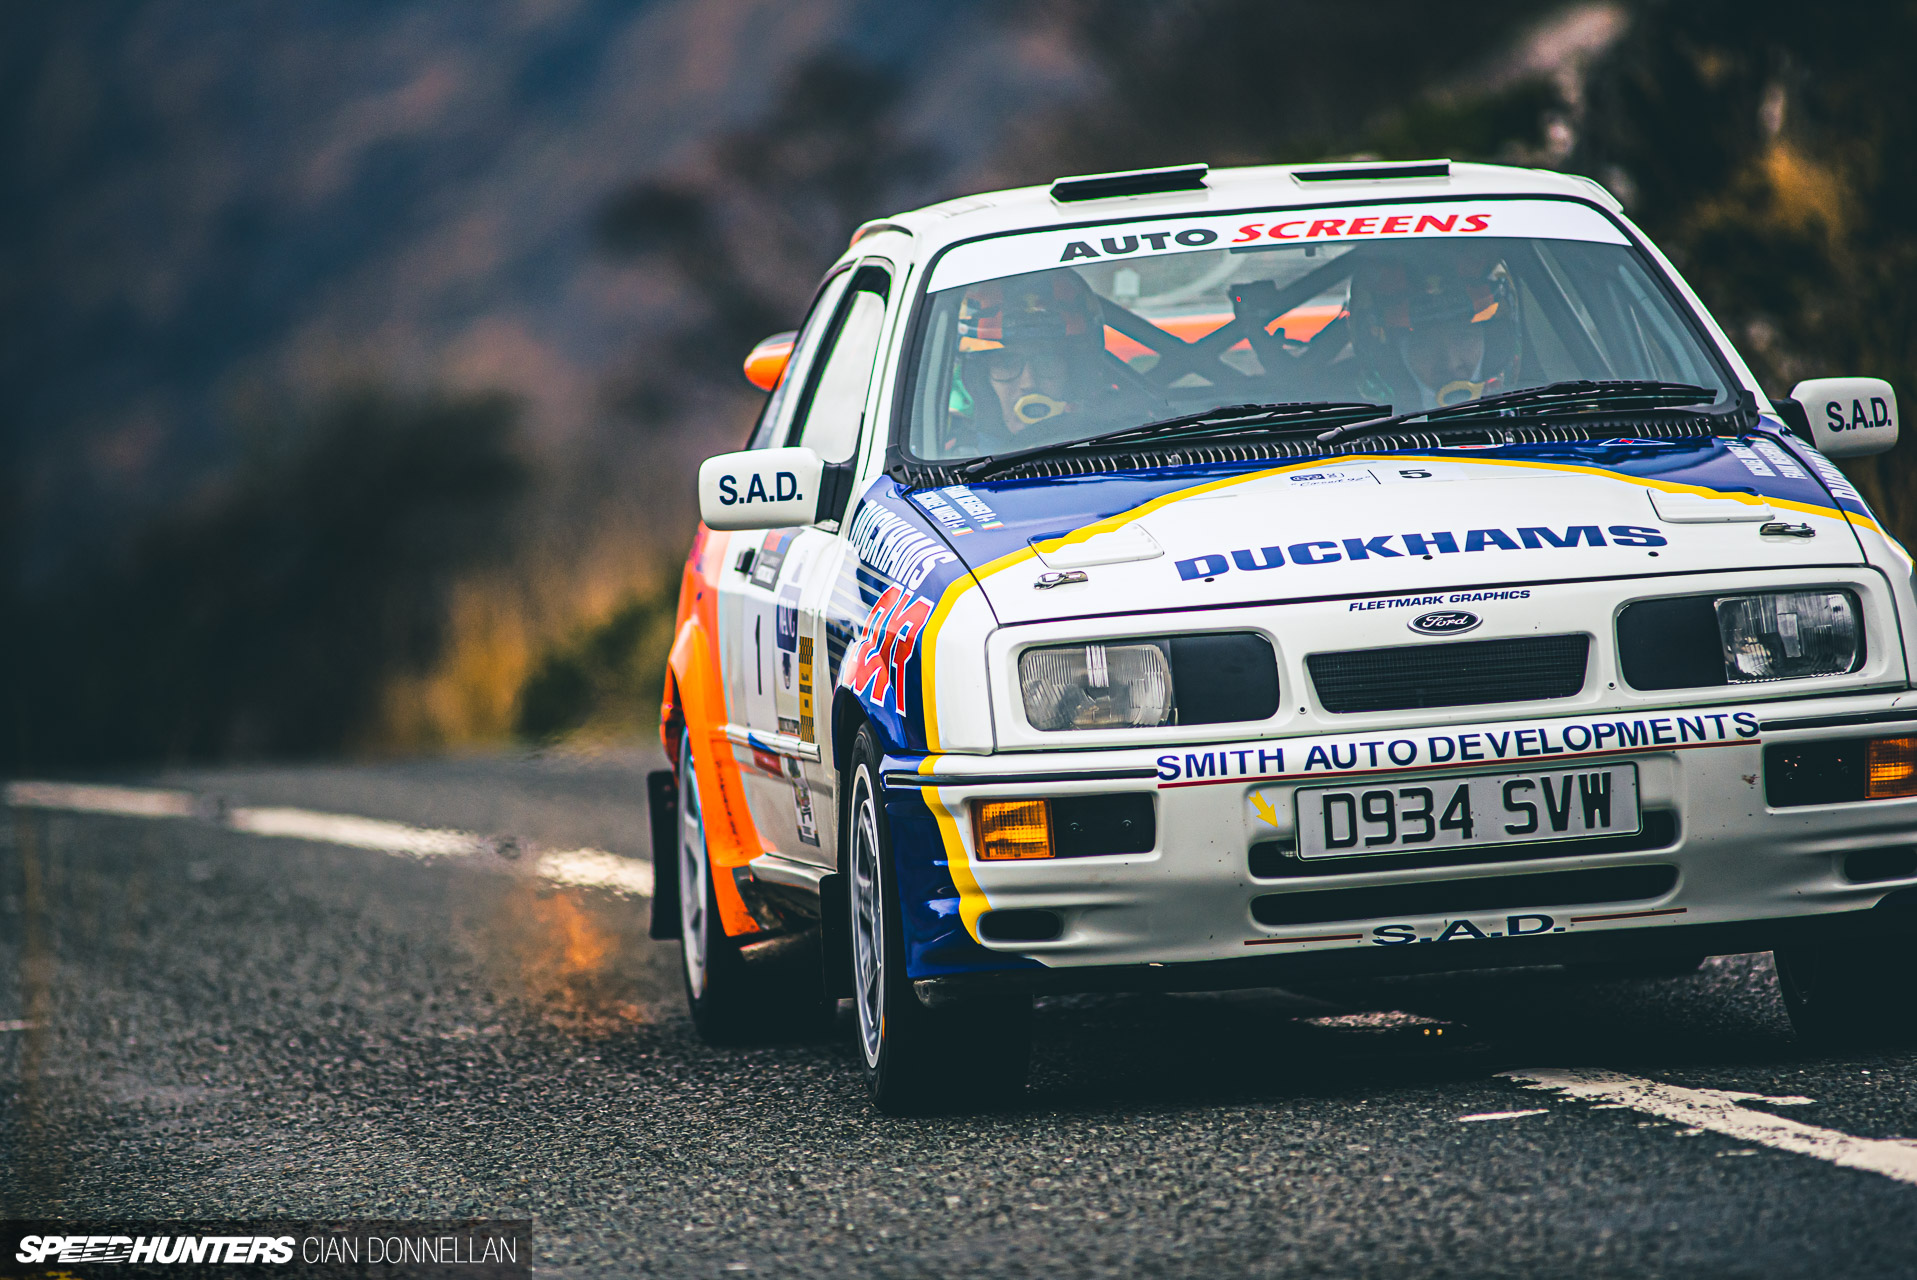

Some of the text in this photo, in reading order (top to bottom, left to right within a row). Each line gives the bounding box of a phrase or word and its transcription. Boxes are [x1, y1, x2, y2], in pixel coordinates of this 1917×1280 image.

[1060, 214, 1493, 262] AUTO SCREENS
[1826, 397, 1892, 432] S.A.D.
[719, 471, 803, 506] S.A.D.
[1399, 469, 1432, 479] 5
[848, 498, 958, 591] DUCKHAMS
[1175, 525, 1668, 581] DUCKHAMS
[1349, 591, 1531, 612] FLEETMARK GRAPHICS
[1422, 614, 1468, 632] Ford
[1157, 711, 1760, 782] SMITH AUTO DEVELOPMENTS
[1323, 772, 1612, 850] D934 SVW
[1372, 914, 1567, 946] S.A.D.
